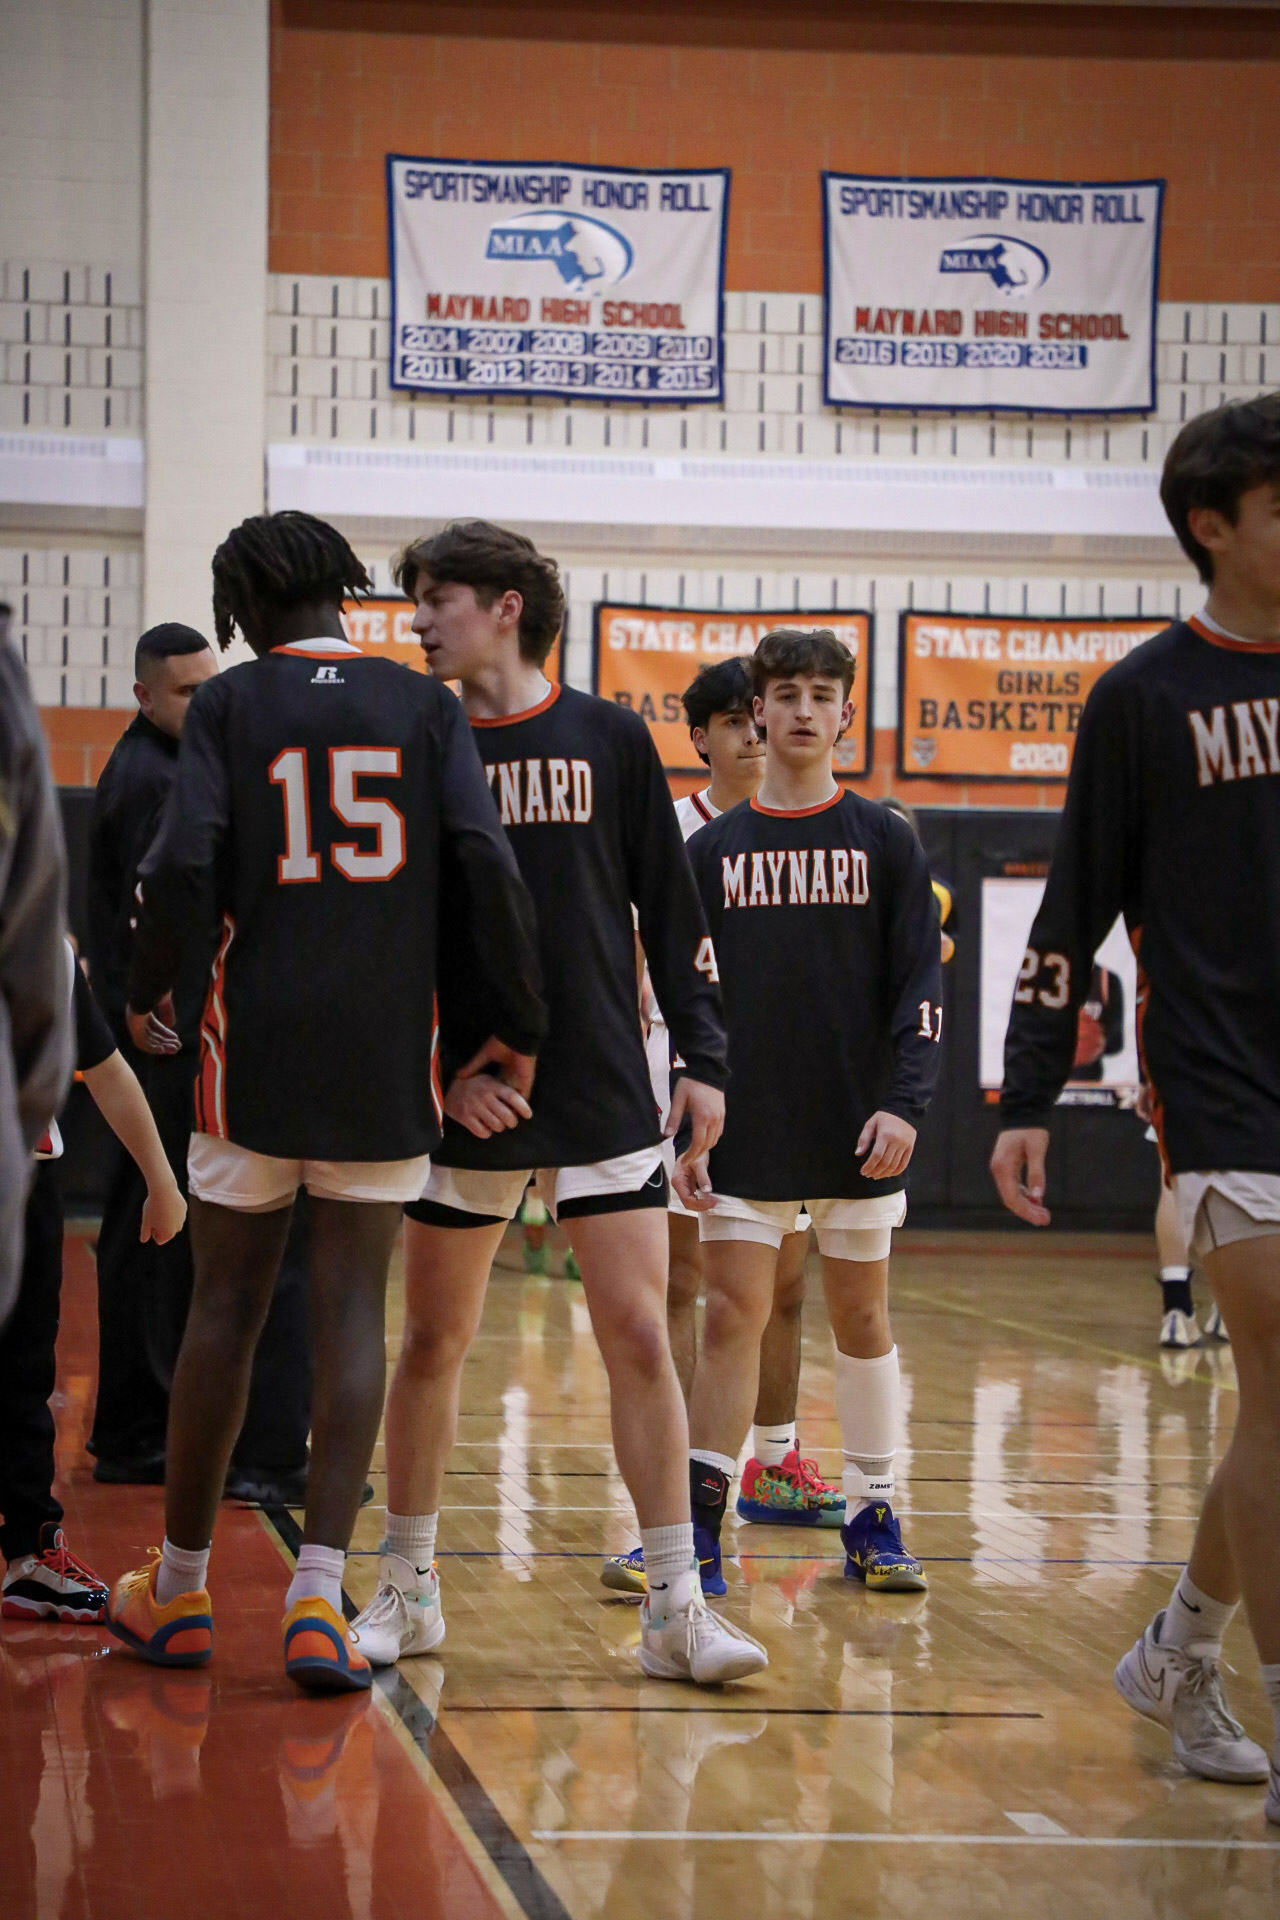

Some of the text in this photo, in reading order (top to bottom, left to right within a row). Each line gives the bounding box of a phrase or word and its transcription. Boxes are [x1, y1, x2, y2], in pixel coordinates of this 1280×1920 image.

[404, 169, 712, 212] SPORTSMANSHIP HONOR ROLL
[840, 185, 1145, 224] SPORTSMANSHIP HONOR ROLL
[491, 234, 564, 256] MIAA
[943, 252, 997, 270] MIAA
[426, 293, 686, 330] MAYNARD HIGH SCHOOL
[855, 306, 1130, 341] MAYNARD HIGH SCHOOL
[403, 328, 711, 359] 2004 2007 2008 2009 2010
[838, 340, 1082, 367] 2016 2019 2020 2021
[404, 356, 712, 389] 2011 2012 2013 2014 2015
[608, 617, 696, 651] STATE
[914, 625, 1159, 662] STATE CHAMPIO
[997, 669, 1080, 696] GIRLS
[918, 699, 1085, 732] BASKETB
[1010, 742, 1068, 771] 2020
[268, 745, 407, 885] 15
[721, 848, 870, 909] MAYNARD
[1013, 947, 1071, 1010] 23
[917, 999, 943, 1043] 11
